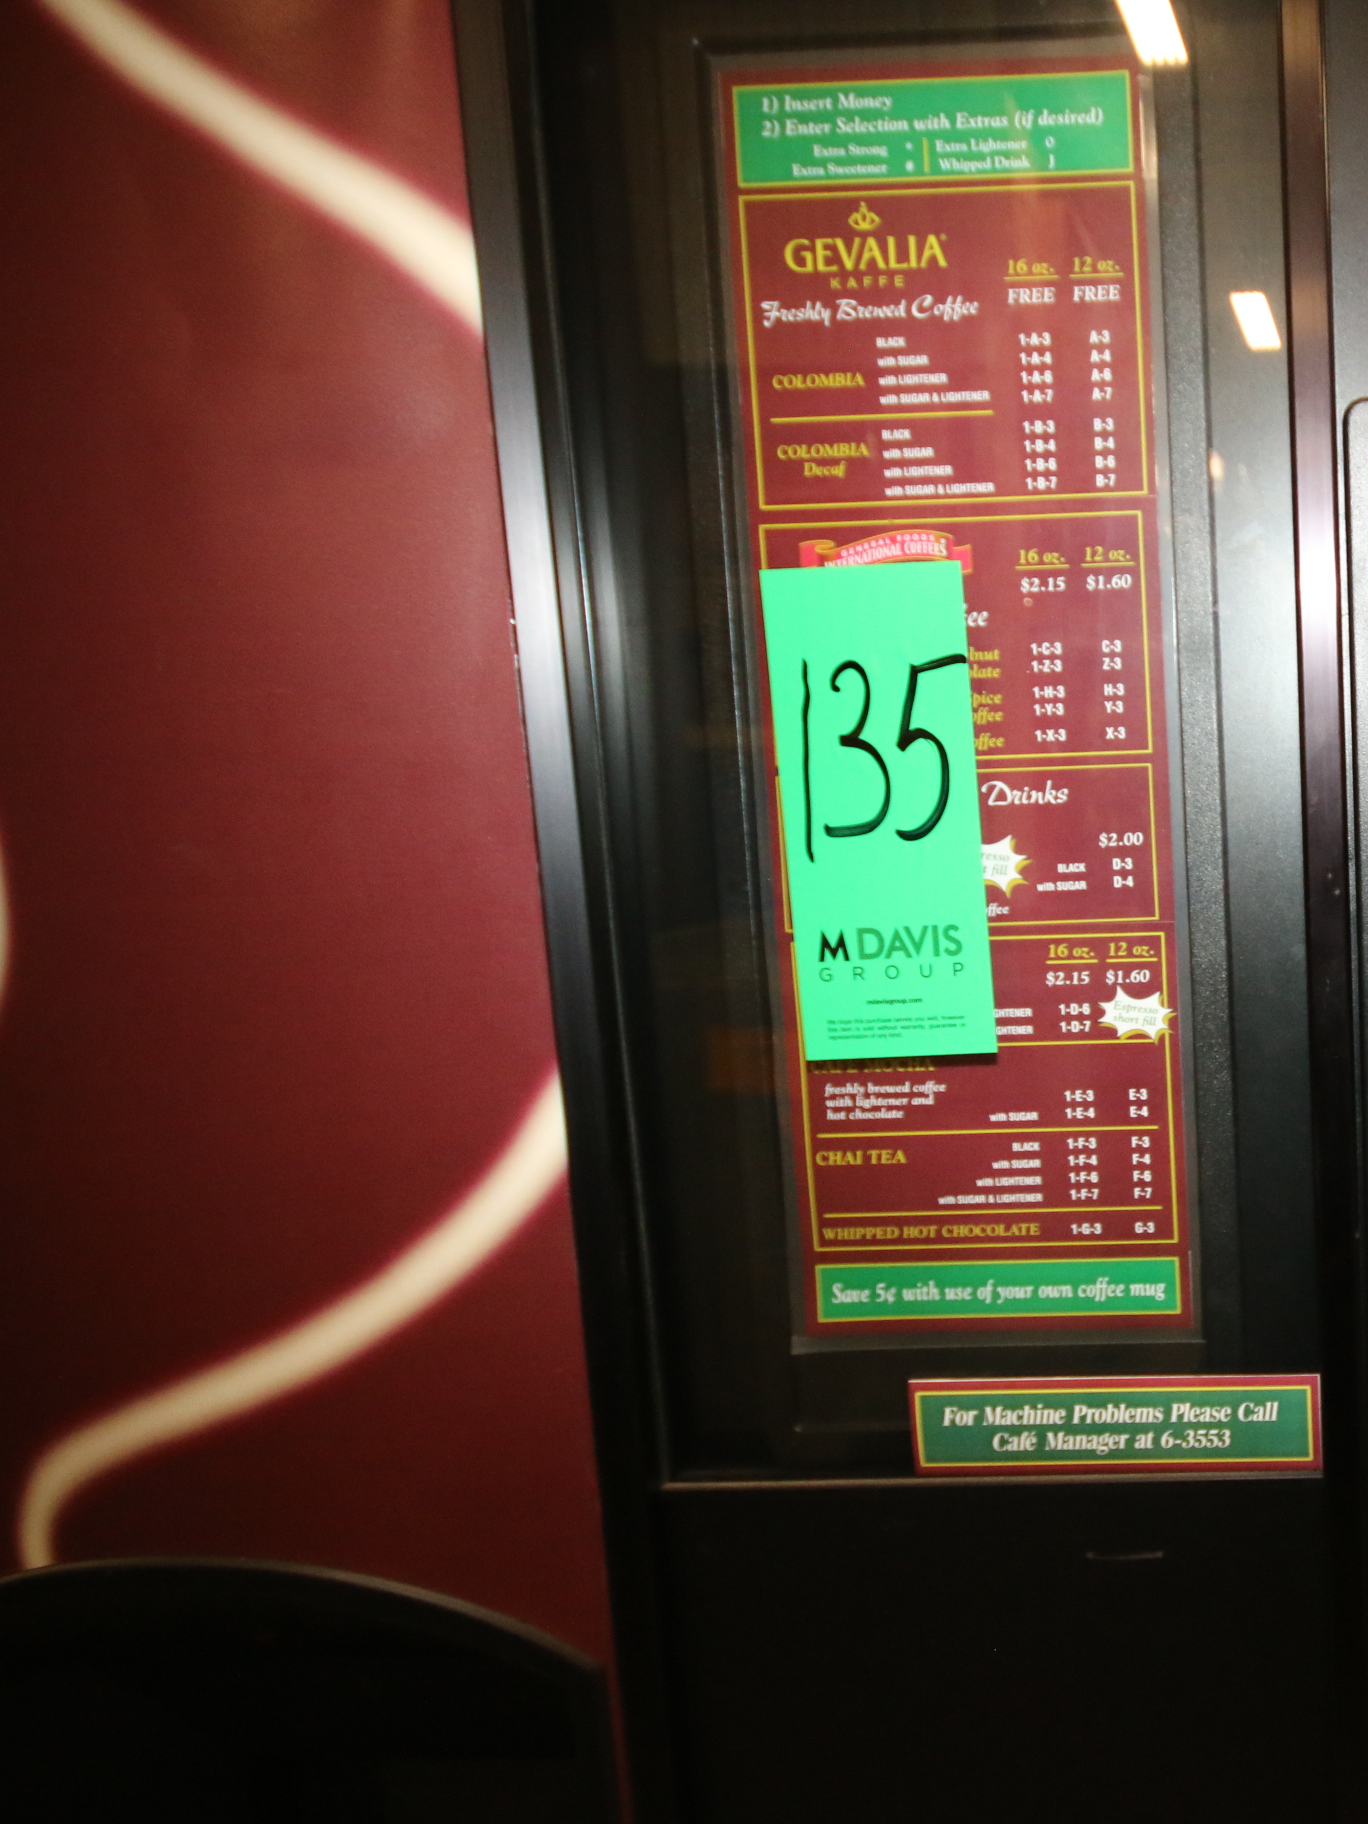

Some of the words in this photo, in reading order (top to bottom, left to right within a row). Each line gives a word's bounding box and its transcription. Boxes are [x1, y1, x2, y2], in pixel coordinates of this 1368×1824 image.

[761, 96, 779, 113] 1)
[783, 93, 833, 112] Insert
[837, 93, 893, 112] Money
[761, 119, 780, 137] 2)
[785, 118, 830, 136] Enter
[836, 114, 908, 135] Selection
[914, 114, 950, 132] with
[956, 111, 1008, 129] Extras
[1014, 111, 1033, 130] (if
[1039, 107, 1103, 128] desired)
[784, 234, 947, 273] GEVALIA
[1007, 258, 1028, 275] 16
[1033, 261, 1055, 275] oz.
[1072, 255, 1092, 273] 12
[1097, 258, 1120, 272] oz.
[830, 275, 905, 288] KAFFE
[1007, 287, 1055, 303] FREE
[1073, 285, 1120, 301] FREE
[761, 300, 831, 327] Freshly
[836, 297, 907, 321] Brewed
[911, 294, 979, 321] Coffee
[876, 337, 905, 347] BLACK
[1019, 332, 1050, 346] 1-A-3
[1090, 331, 1110, 344] A-3
[1020, 351, 1052, 365] 1-A-4
[1091, 349, 1111, 363] A-4
[772, 373, 865, 389] COLOMBIA
[1021, 370, 1052, 384] 1-A-6
[1091, 368, 1112, 382] A-6
[1021, 389, 1053, 402] 1-A-7
[1092, 387, 1112, 400] A-7
[777, 442, 869, 459] COLOMBIA
[804, 461, 847, 477] Decaf
[1018, 549, 1038, 564] 16
[1043, 551, 1065, 563] oz.
[1084, 546, 1104, 561] 12
[1109, 549, 1131, 561] oz.
[1021, 576, 1066, 594] $2.15
[1087, 573, 1132, 591] $1.60
[1031, 642, 1062, 656] 1-C-3
[1102, 640, 1122, 653] C-3
[1032, 659, 1062, 673] 1-Z-3
[1103, 657, 1122, 670] Z-3
[1032, 685, 1065, 699] 1-H-3
[1104, 684, 1124, 697] H-3
[1034, 703, 1064, 717] 1-Y-3
[1104, 701, 1123, 715] Y-3
[1035, 729, 1067, 743] 1-X-3
[1105, 727, 1126, 740] X-3
[803, 653, 967, 863] 135
[981, 779, 1069, 806] Drinks
[1099, 831, 1143, 848] $2.00
[1113, 858, 1133, 871] D-3
[1113, 875, 1133, 888] D-4
[819, 962, 965, 983] GROUP
[1046, 971, 1090, 987] $2.15
[1105, 970, 1150, 985] $1.60
[1059, 1003, 1091, 1016] 1-D-6
[1113, 1001, 1158, 1016] Espresso
[1113, 1012, 1137, 1024] short
[1140, 1014, 1157, 1027] fill
[1060, 1021, 1091, 1034] 1-D-7
[1064, 1090, 1094, 1103] 1-E-3
[1129, 1089, 1148, 1101] E-3
[1065, 1107, 1095, 1120] 1-E-4
[1129, 1106, 1149, 1119] E-4
[816, 1151, 863, 1166] CHAI
[870, 1149, 907, 1164] TEA
[823, 1226, 899, 1241] WHIPPED
[902, 1224, 936, 1239] HOT
[942, 1223, 1041, 1238] CHOCOLATE
[1071, 1223, 1102, 1236] 1-G-3
[1135, 1222, 1155, 1235] G-3
[831, 1283, 871, 1305] Save
[902, 1282, 940, 1302] with
[945, 1285, 972, 1301] use
[977, 1279, 995, 1304] of
[998, 1283, 1034, 1304] your
[1038, 1282, 1073, 1299] own
[1078, 1277, 1124, 1302] coffee
[1129, 1281, 1166, 1301] mug
[943, 1406, 977, 1427] For
[982, 1404, 1066, 1426] Machine
[1072, 1403, 1164, 1425] Problems
[1170, 1403, 1232, 1423] Please
[1237, 1401, 1279, 1422] Call
[992, 1432, 1036, 1452] Café
[1045, 1433, 1129, 1455] Manager
[1134, 1432, 1154, 1448] at
[1160, 1429, 1232, 1448] 6-3553
